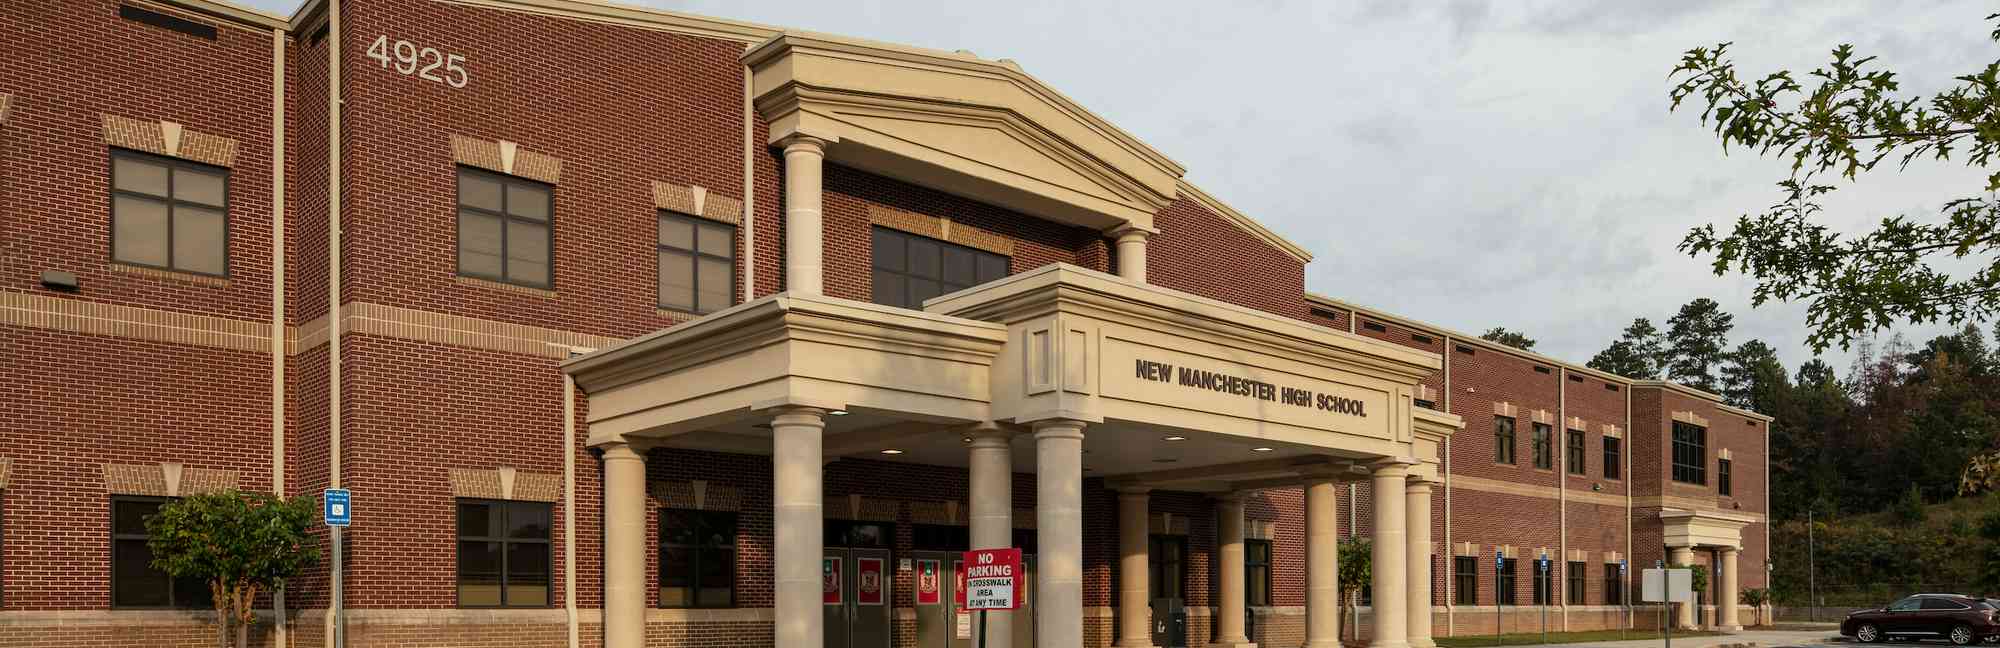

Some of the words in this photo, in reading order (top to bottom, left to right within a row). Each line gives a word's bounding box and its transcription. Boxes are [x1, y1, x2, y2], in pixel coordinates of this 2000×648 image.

[366, 34, 468, 89] 4925
[1135, 359, 1173, 383] NEW
[1178, 366, 1277, 402] MANCHESTER
[1281, 386, 1313, 409] HIGH
[1316, 392, 1367, 418] SCHOOL
[978, 553, 993, 564] NO
[967, 565, 1012, 577] PARKING
[973, 578, 1012, 587] CROSSWALK
[976, 589, 993, 597] AREA
[975, 598, 987, 607] ANY
[988, 599, 1007, 607] TIME
